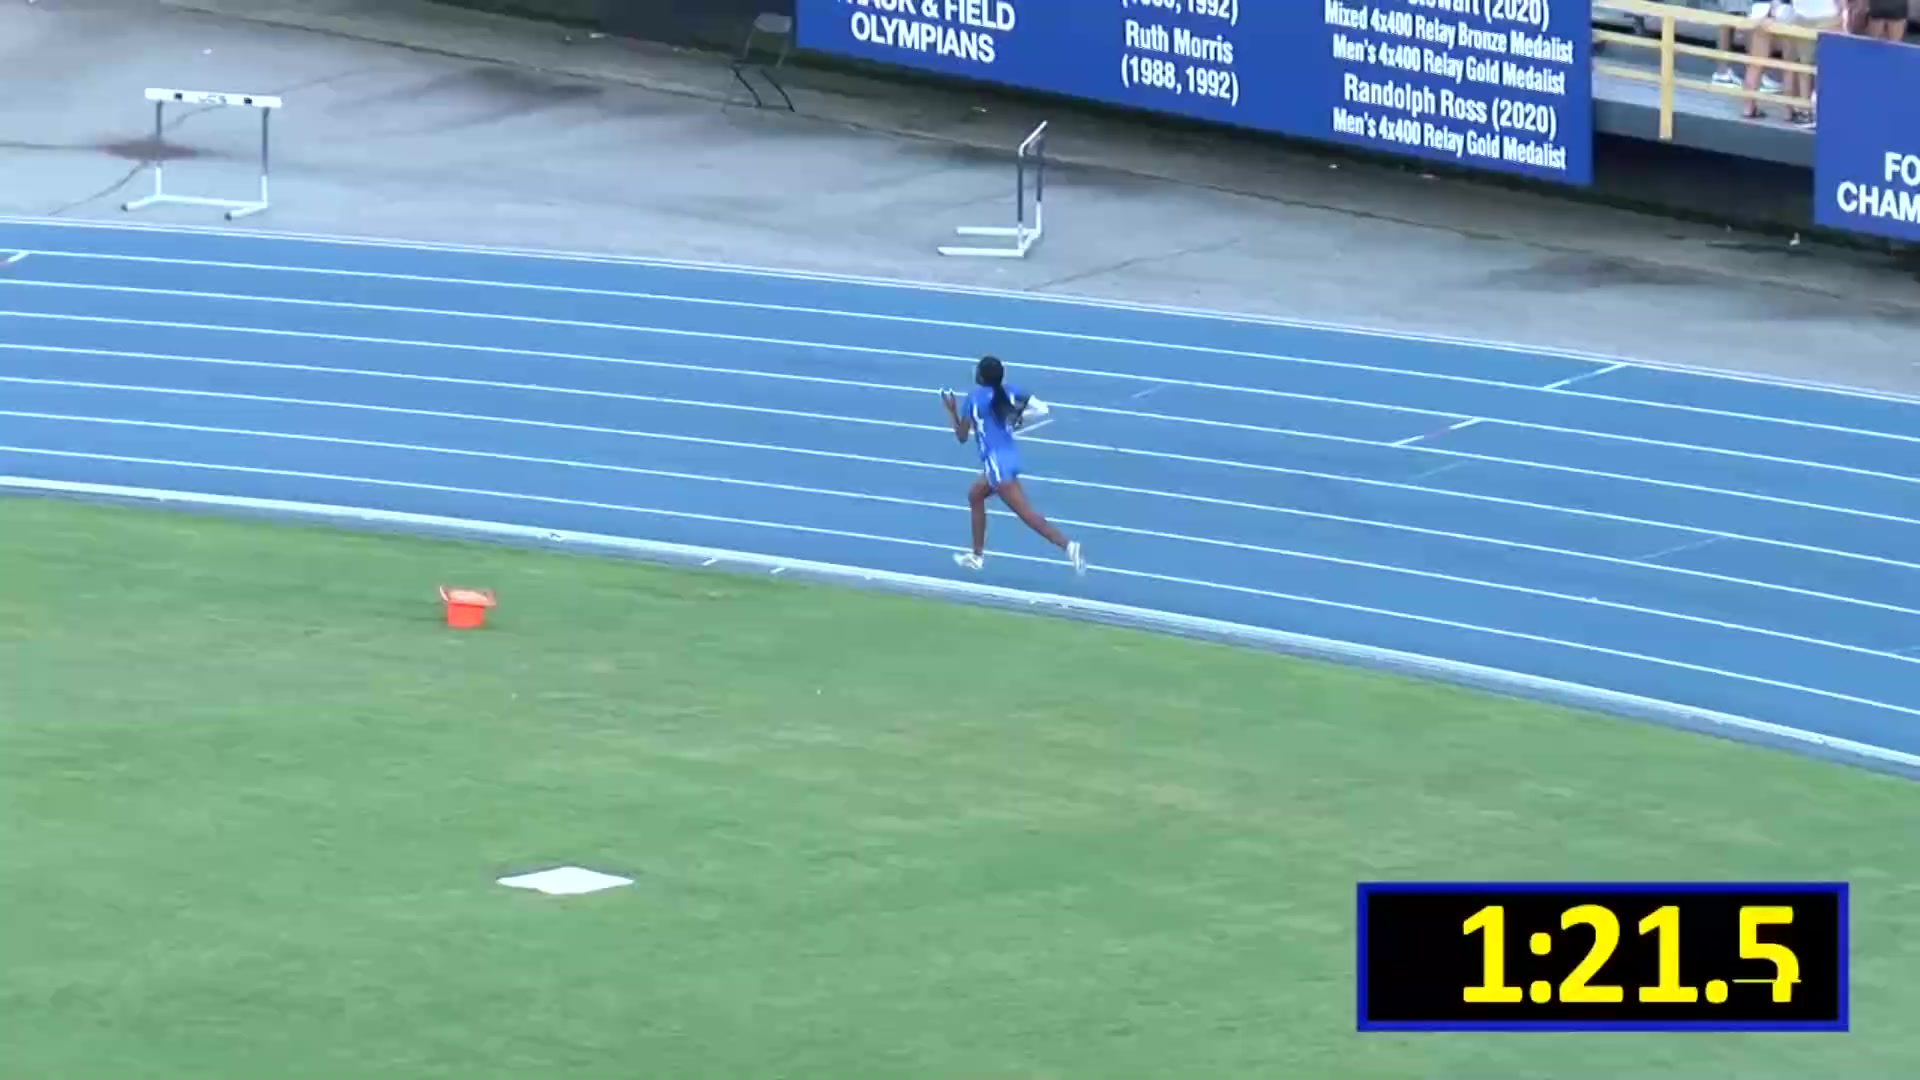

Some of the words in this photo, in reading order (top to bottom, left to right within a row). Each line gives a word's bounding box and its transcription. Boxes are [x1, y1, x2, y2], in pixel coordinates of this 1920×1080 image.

[851, 11, 996, 63] OLYMPIANS
[921, 0, 940, 19] &
[944, 0, 1016, 31] FIELD
[1325, 0, 1368, 30] Mixed
[1370, 8, 1413, 38] 4x400
[1415, 14, 1456, 50] Relay
[1458, 21, 1508, 53] Bronze
[1510, 30, 1574, 64] Medalist
[1484, 0, 1550, 33] (2020)
[1125, 19, 1169, 53] Ruth
[1173, 27, 1234, 65] Morris
[1333, 33, 1377, 64] Men's
[1378, 42, 1421, 72] 4x400
[1423, 48, 1464, 84] Relay
[1466, 55, 1500, 85] Gold
[1502, 61, 1566, 95] Medalist
[1121, 53, 1183, 96] (1988,
[1185, 65, 1240, 107] 1992)
[1343, 72, 1436, 118] Randolph
[1440, 88, 1488, 124] Ross
[1492, 97, 1557, 142] (2020)
[1333, 106, 1377, 138] Men's
[1379, 114, 1422, 146] 4x400
[1424, 122, 1465, 158] Relay
[1467, 129, 1500, 159] Gold
[1503, 135, 1567, 170] Medalist
[1884, 151, 1920, 187] FO
[1836, 180, 1920, 224] CHAM
